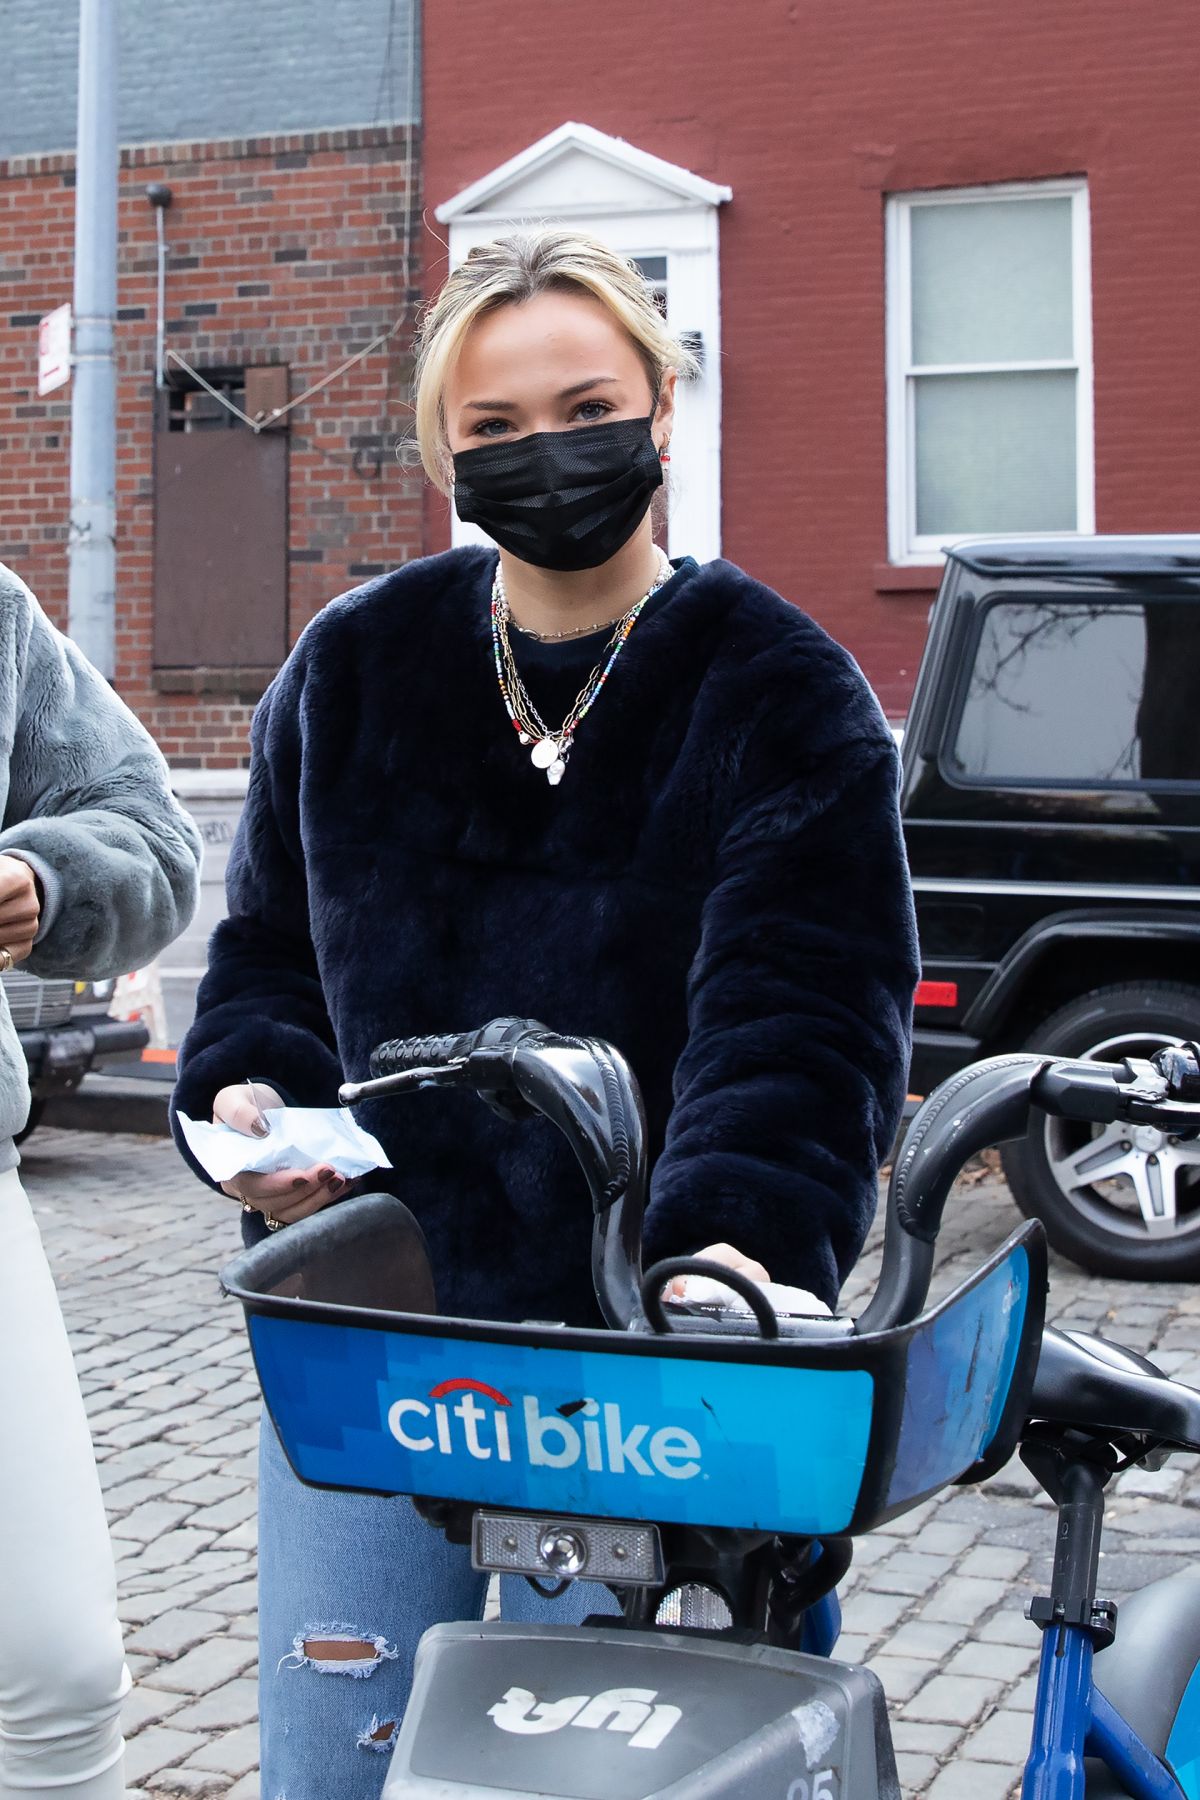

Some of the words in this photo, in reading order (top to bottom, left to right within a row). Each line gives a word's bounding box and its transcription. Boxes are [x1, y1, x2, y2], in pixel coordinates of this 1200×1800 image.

[388, 1379, 512, 1461] citi
[522, 1395, 701, 1480] bike
[487, 1687, 683, 1750] lyft
